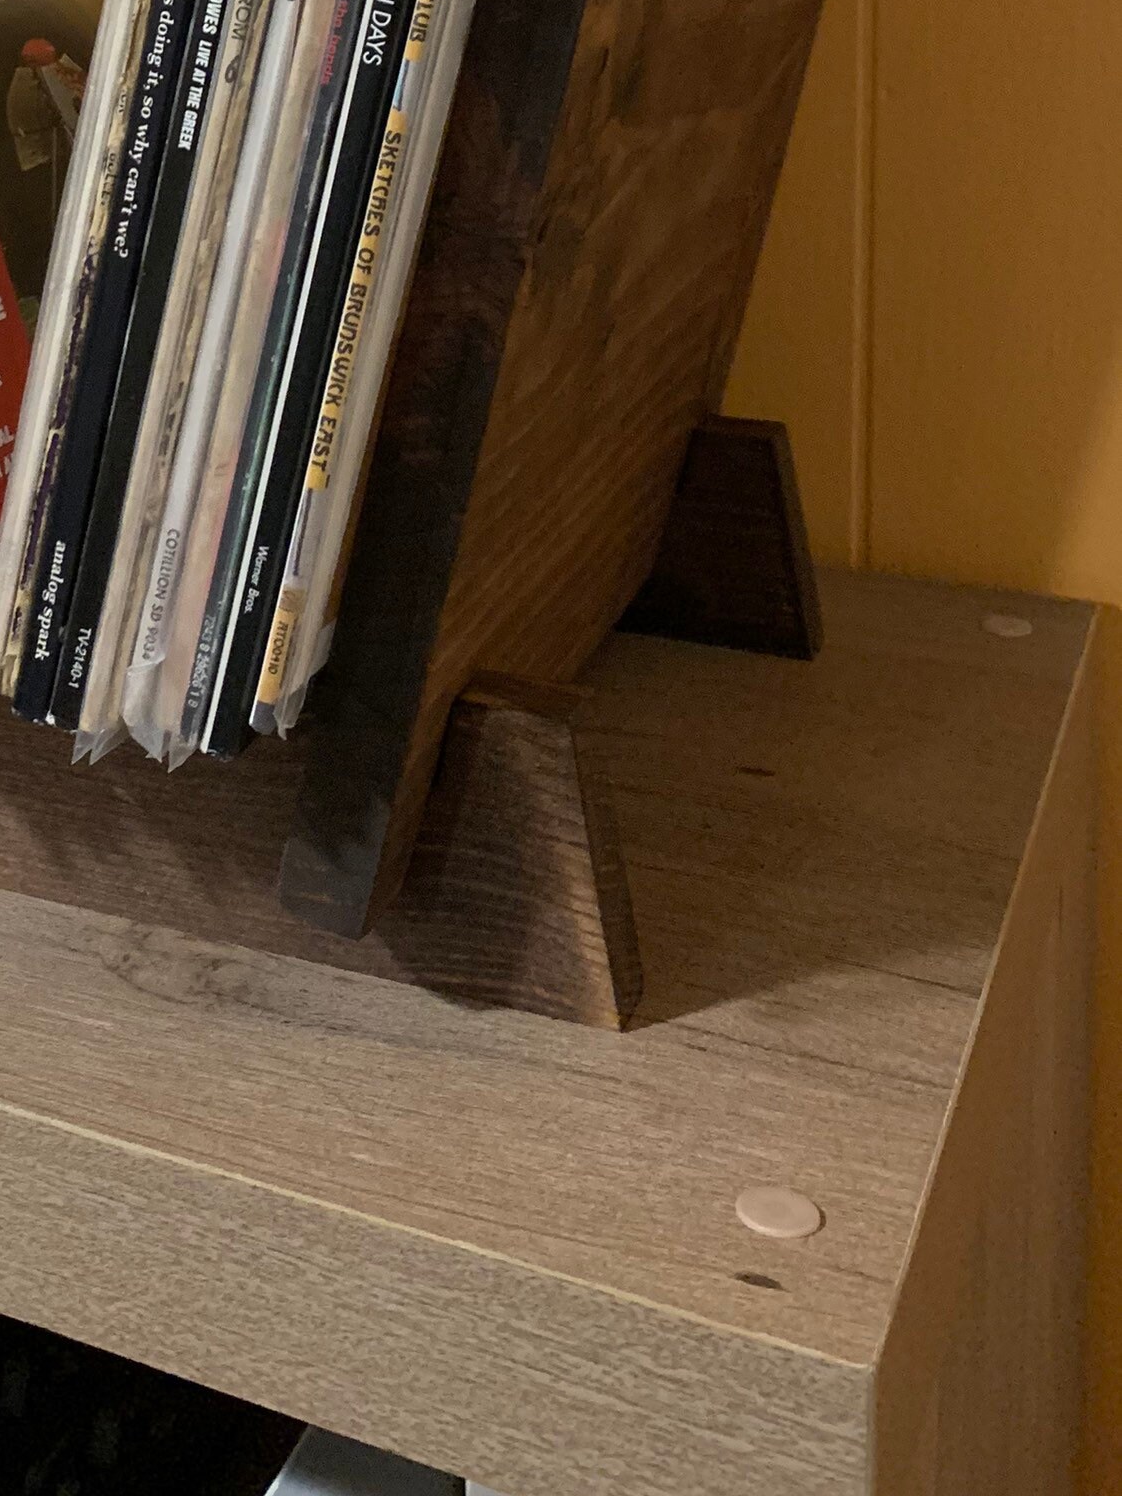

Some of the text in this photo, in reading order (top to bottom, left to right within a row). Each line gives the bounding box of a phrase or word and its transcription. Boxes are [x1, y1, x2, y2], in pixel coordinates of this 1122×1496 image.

[147, 9, 175, 68] doing
[194, 39, 213, 68] LIVE
[319, 33, 341, 86] bends
[362, 8, 390, 66] DAYS
[143, 69, 163, 92] it,
[186, 84, 203, 108] THE
[191, 67, 206, 83] AT
[139, 95, 154, 119] so
[178, 109, 197, 150] GREEK
[127, 121, 150, 164] why
[120, 167, 143, 217] can't
[112, 220, 132, 258] we?
[310, 129, 402, 472] SKETCHES OF BRUNSWICK EAST
[153, 527, 181, 600] COTILLION
[243, 544, 269, 615] Warner Bros.
[31, 539, 69, 661] analog spark
[149, 603, 163, 622] SD
[68, 627, 91, 688] TV-2140-1
